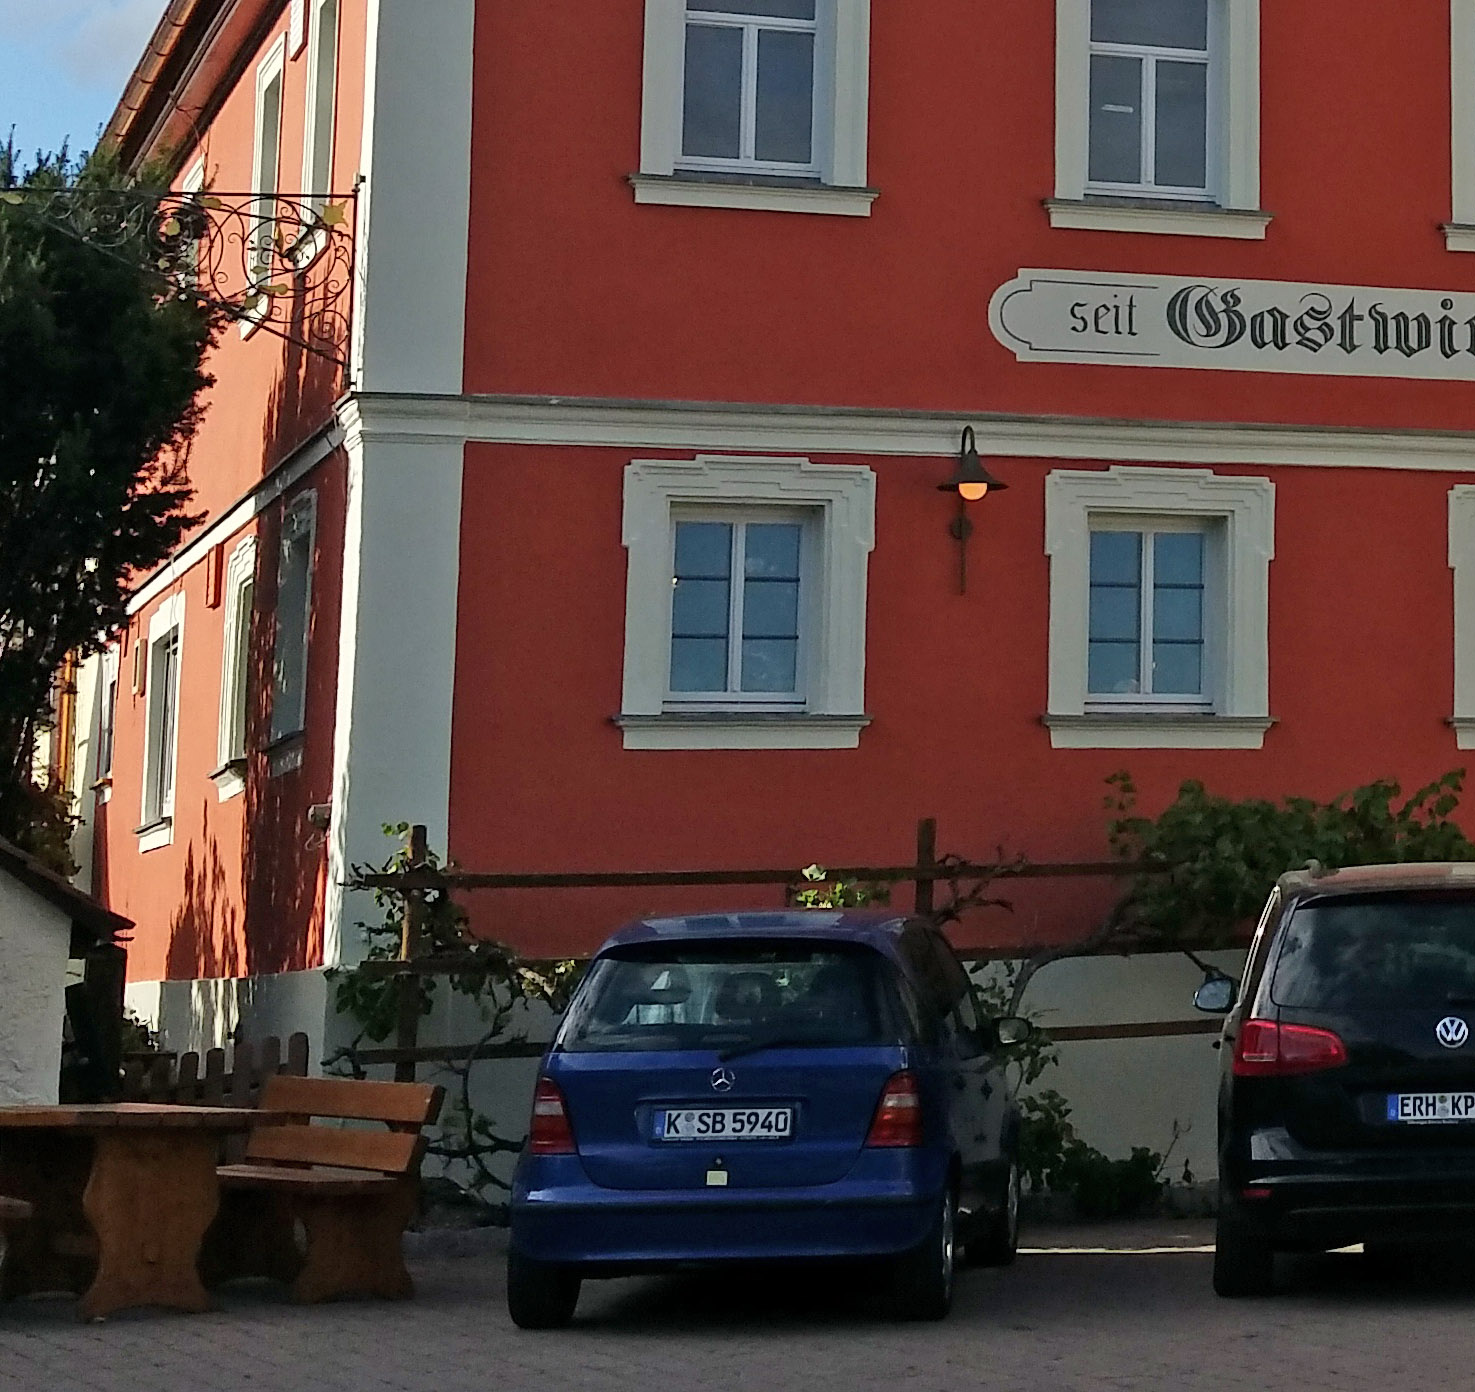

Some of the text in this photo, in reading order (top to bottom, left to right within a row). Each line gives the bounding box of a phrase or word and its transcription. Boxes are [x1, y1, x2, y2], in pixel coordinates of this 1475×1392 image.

[1068, 293, 1139, 337] seit
[1400, 1095, 1437, 1117] ERH
[1451, 1094, 1475, 1116] KP
[666, 1111, 789, 1135] K SB 5940
